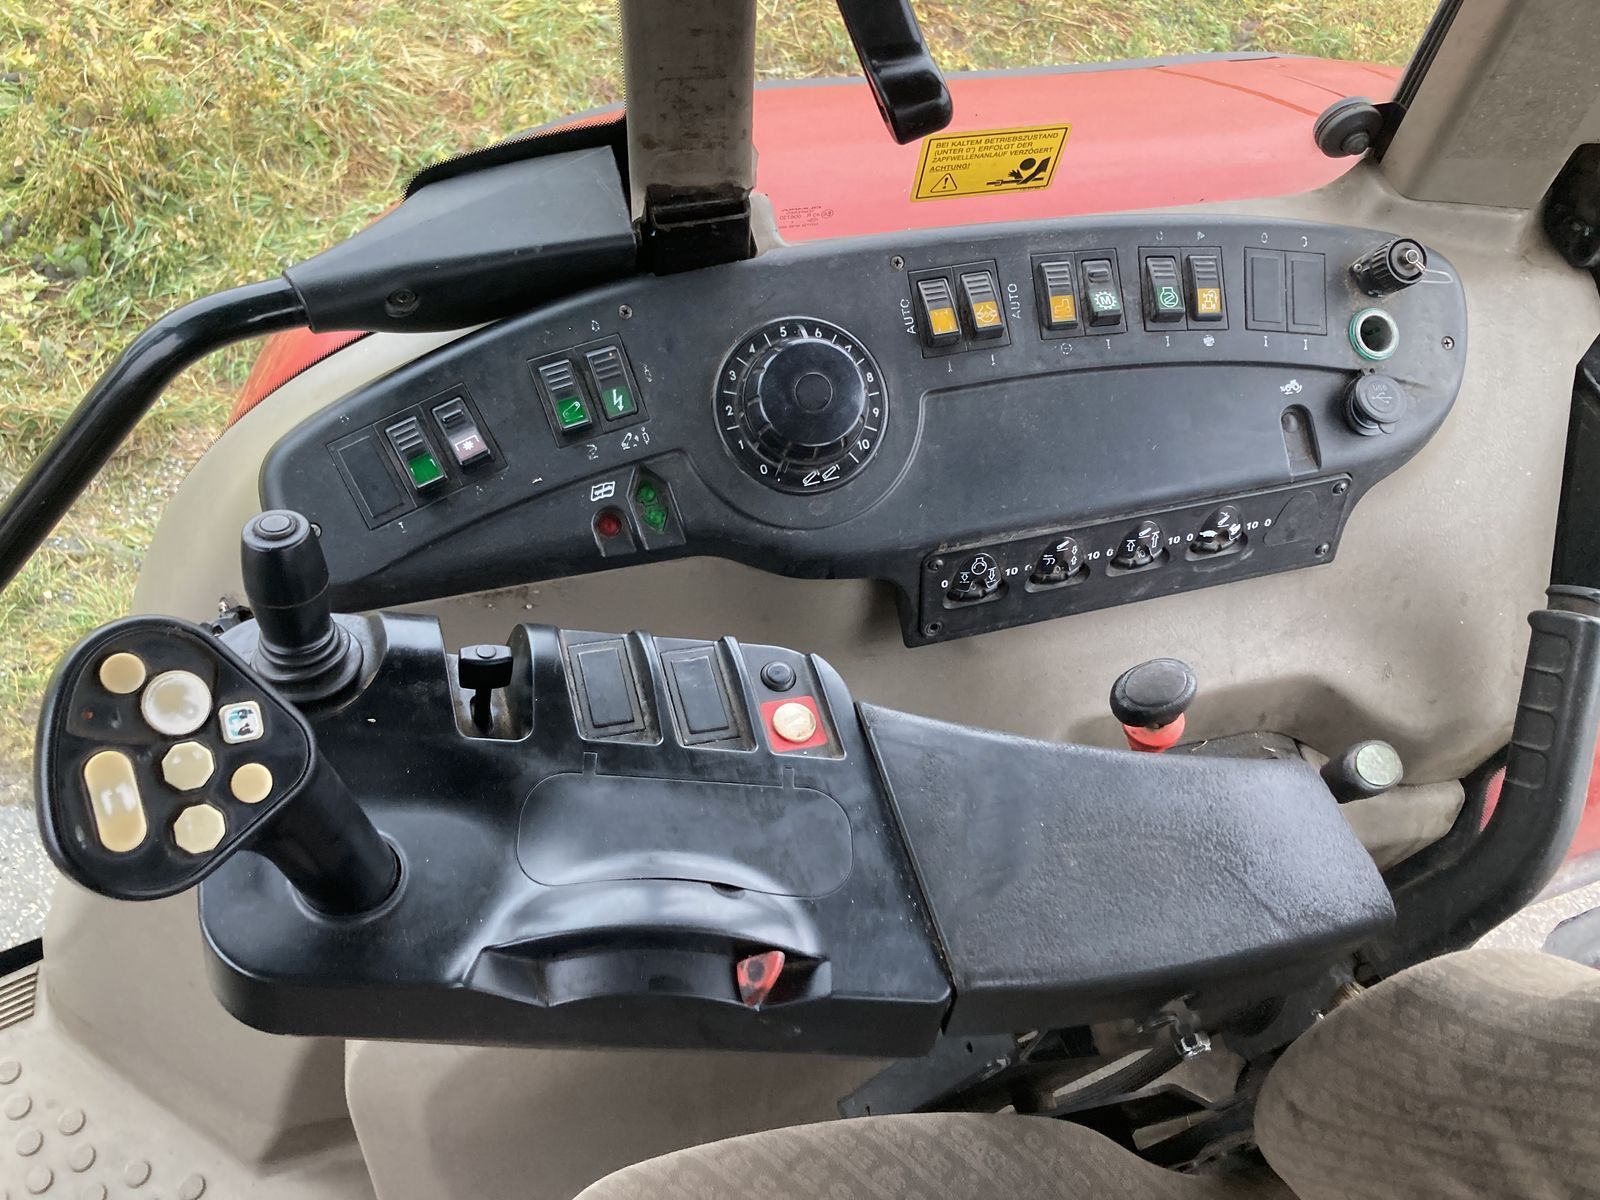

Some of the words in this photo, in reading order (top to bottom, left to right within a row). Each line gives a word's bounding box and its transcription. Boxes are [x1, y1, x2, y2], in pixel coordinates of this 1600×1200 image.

[951, 139, 982, 147] KALTEM
[984, 133, 1059, 144] BETRIEBSZUSTAND
[979, 143, 1015, 152] ERFOLGT
[932, 151, 1008, 163] ZAPFWELLENANLAUF
[1007, 283, 1023, 319] AUTO
[779, 326, 787, 338] 5
[814, 328, 822, 338] 6
[748, 343, 756, 353] 4
[844, 344, 852, 353] 7
[729, 370, 737, 380] 3
[866, 372, 874, 382] 8
[725, 405, 734, 416] 2
[872, 407, 880, 417] 9
[738, 439, 744, 450] 1
[857, 439, 870, 450] 10
[759, 464, 768, 475] 0
[1246, 521, 1259, 530] 10
[1264, 518, 1272, 527] 0
[1168, 536, 1181, 545] 10
[1186, 533, 1194, 542] 0
[1087, 551, 1100, 560] 10
[1106, 548, 1114, 557] 0
[1005, 567, 1018, 576] 10
[941, 579, 949, 588] 0
